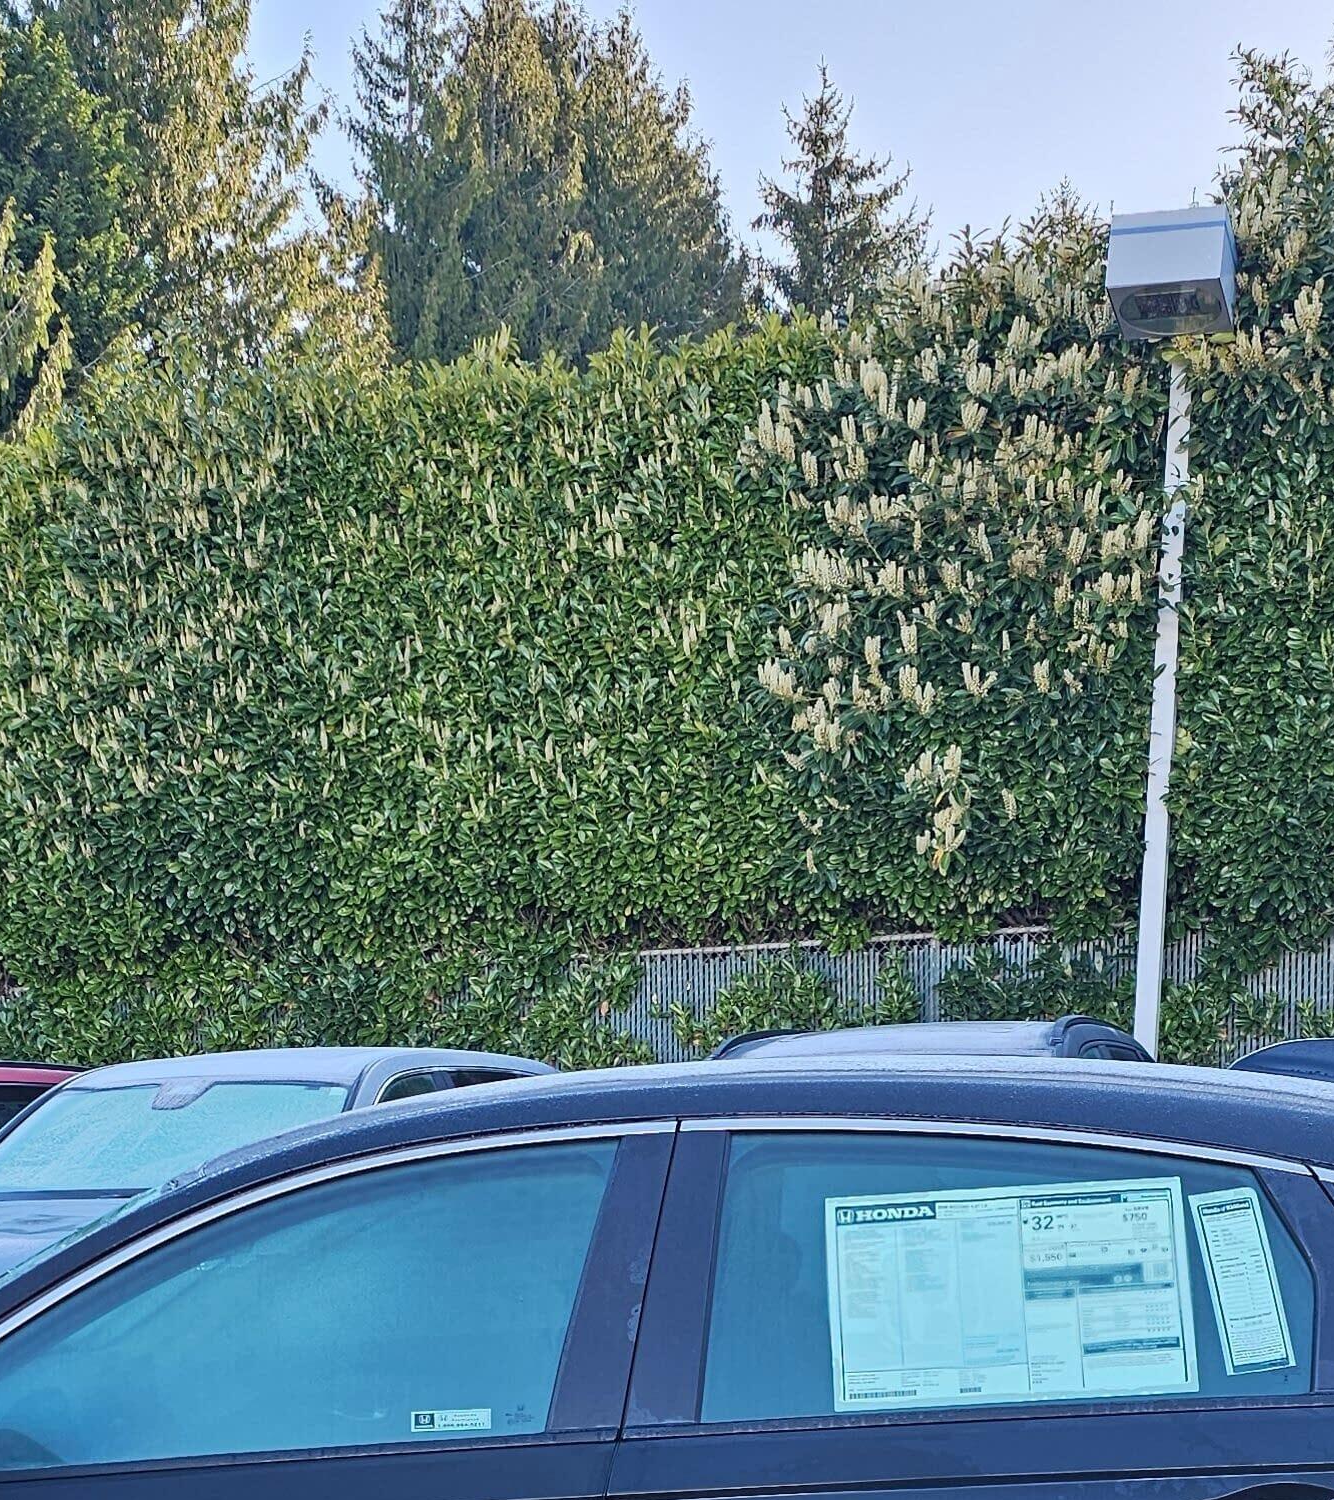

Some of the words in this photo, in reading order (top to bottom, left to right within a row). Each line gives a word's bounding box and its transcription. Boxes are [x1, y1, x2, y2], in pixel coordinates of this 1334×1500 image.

[854, 1205, 935, 1223] HONDA
[1122, 1212, 1148, 1222] $750
[1031, 1215, 1054, 1231] 32
